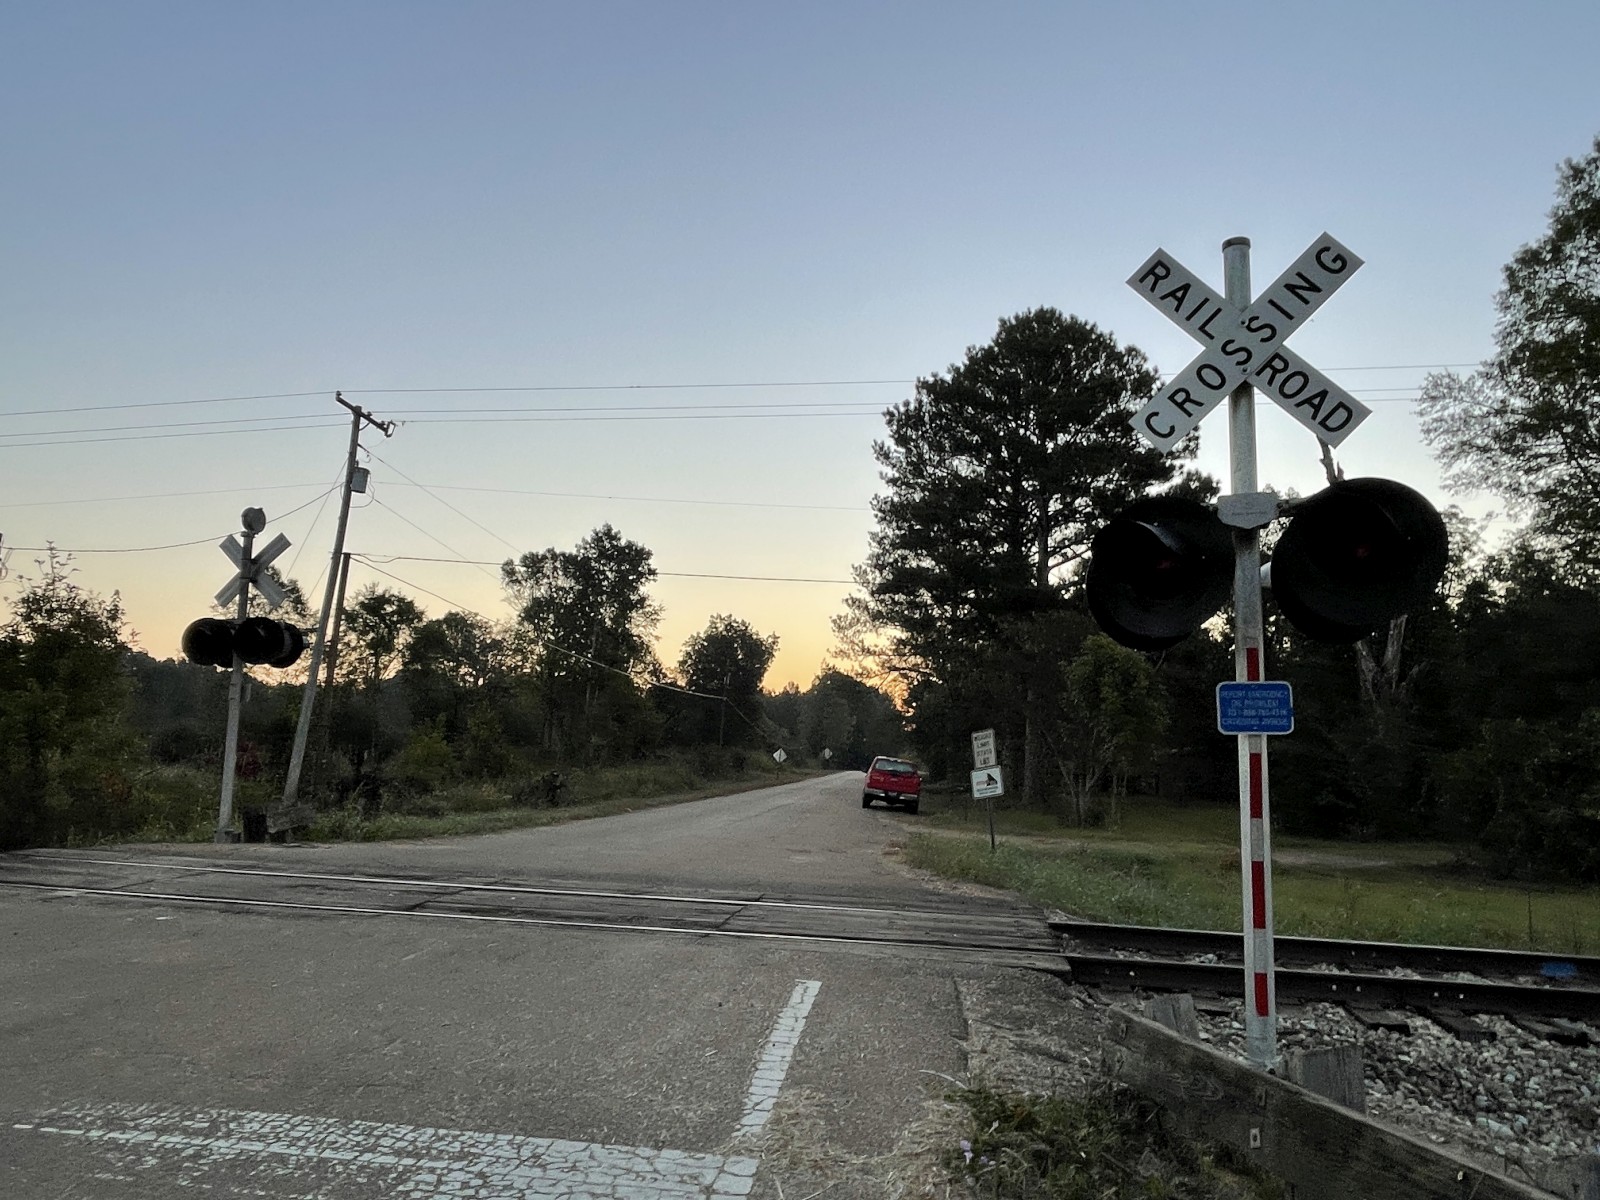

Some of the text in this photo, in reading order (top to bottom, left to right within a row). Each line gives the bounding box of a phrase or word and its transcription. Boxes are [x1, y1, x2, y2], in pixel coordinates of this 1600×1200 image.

[1138, 259, 1354, 433] RAIL ROAD
[1144, 245, 1349, 439] CROSSING
